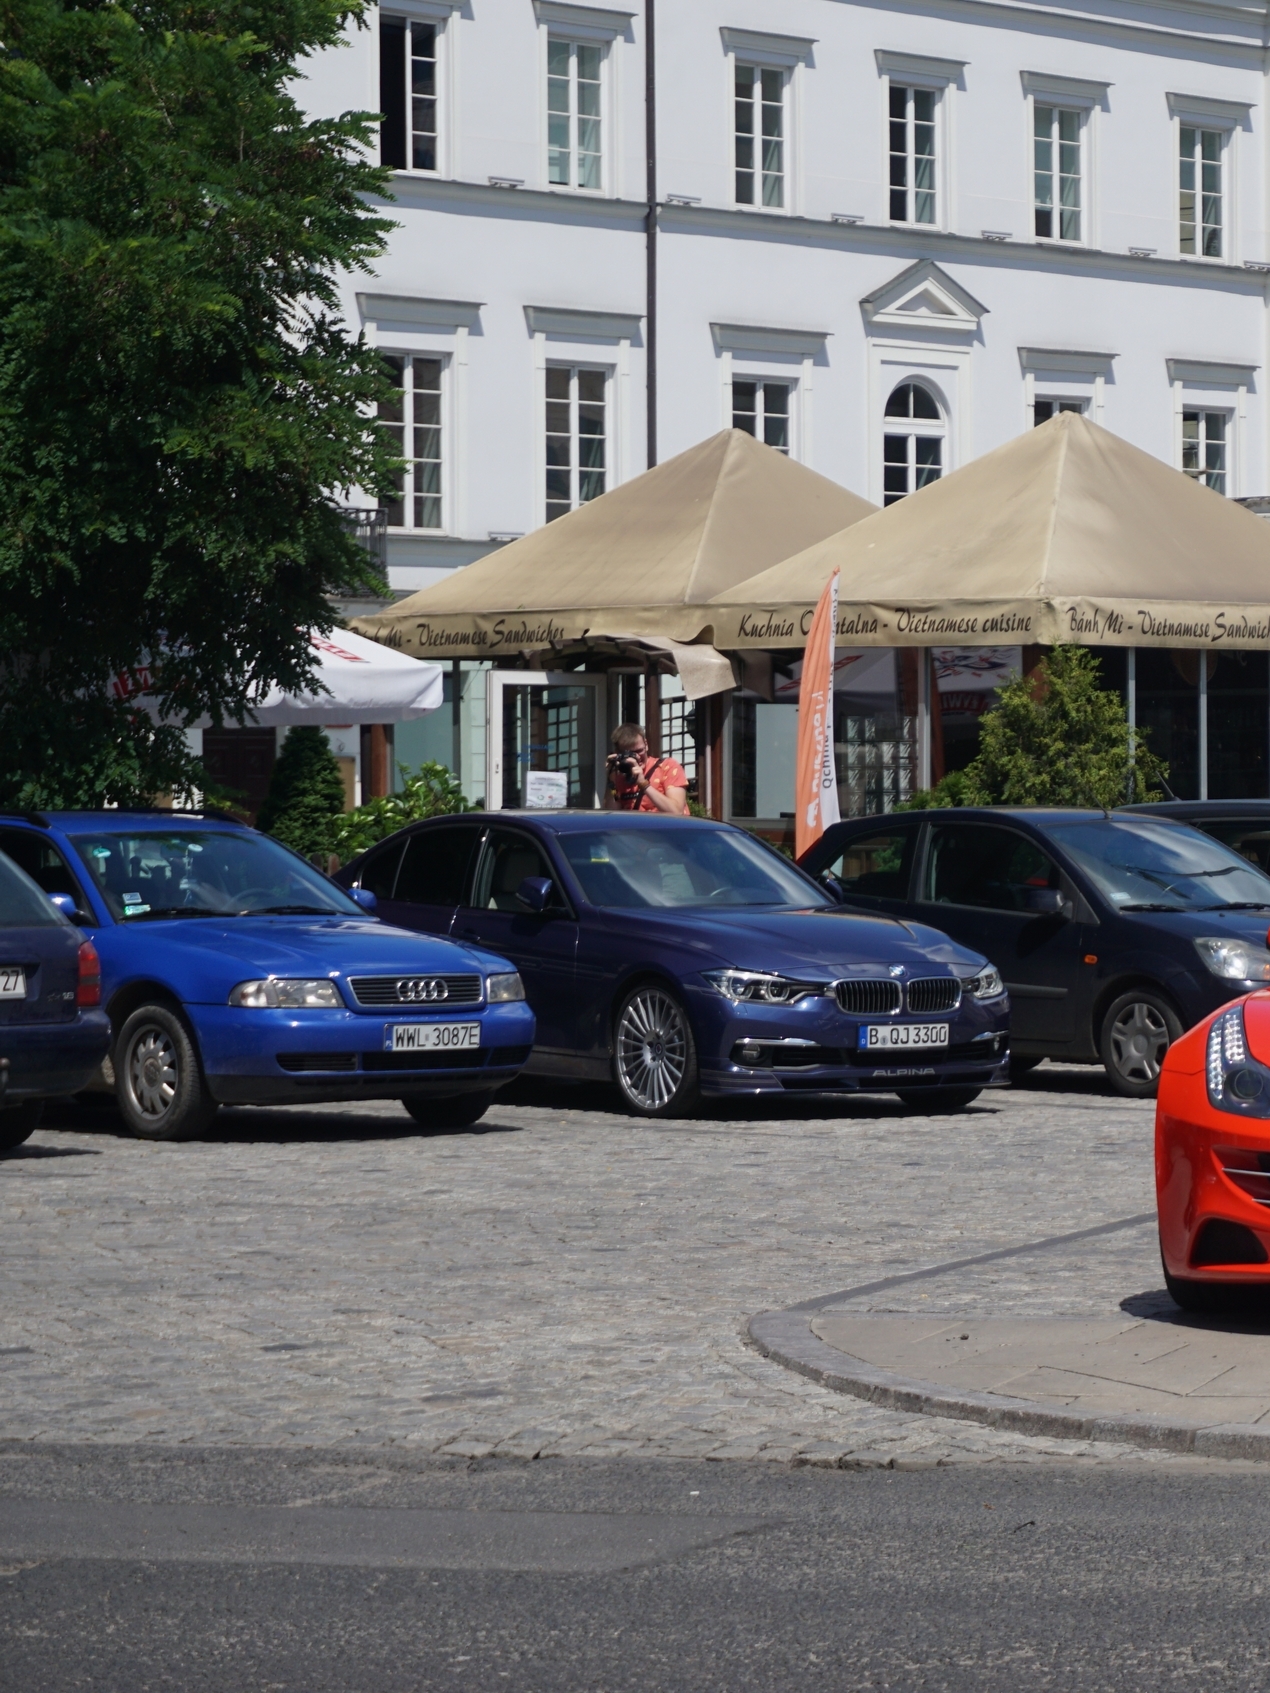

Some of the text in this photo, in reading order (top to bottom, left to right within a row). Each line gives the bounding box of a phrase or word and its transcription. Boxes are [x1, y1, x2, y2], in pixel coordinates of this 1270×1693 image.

[416, 623, 487, 647] Vietnamese
[488, 617, 565, 649] Sandwiches
[737, 610, 794, 638] Kuchnia
[800, 609, 878, 636] Otalna
[895, 607, 978, 634] Vietnamese
[982, 610, 1032, 634] cuisine
[1066, 606, 1099, 634] Bánh
[1138, 609, 1210, 638] Vietnamese
[395, 1027, 427, 1048] WWL
[432, 1025, 480, 1047] 3087E
[869, 1027, 879, 1045] B
[890, 1026, 910, 1044] QJ
[912, 1025, 948, 1044] 3300
[872, 1067, 936, 1077] ALPINA
